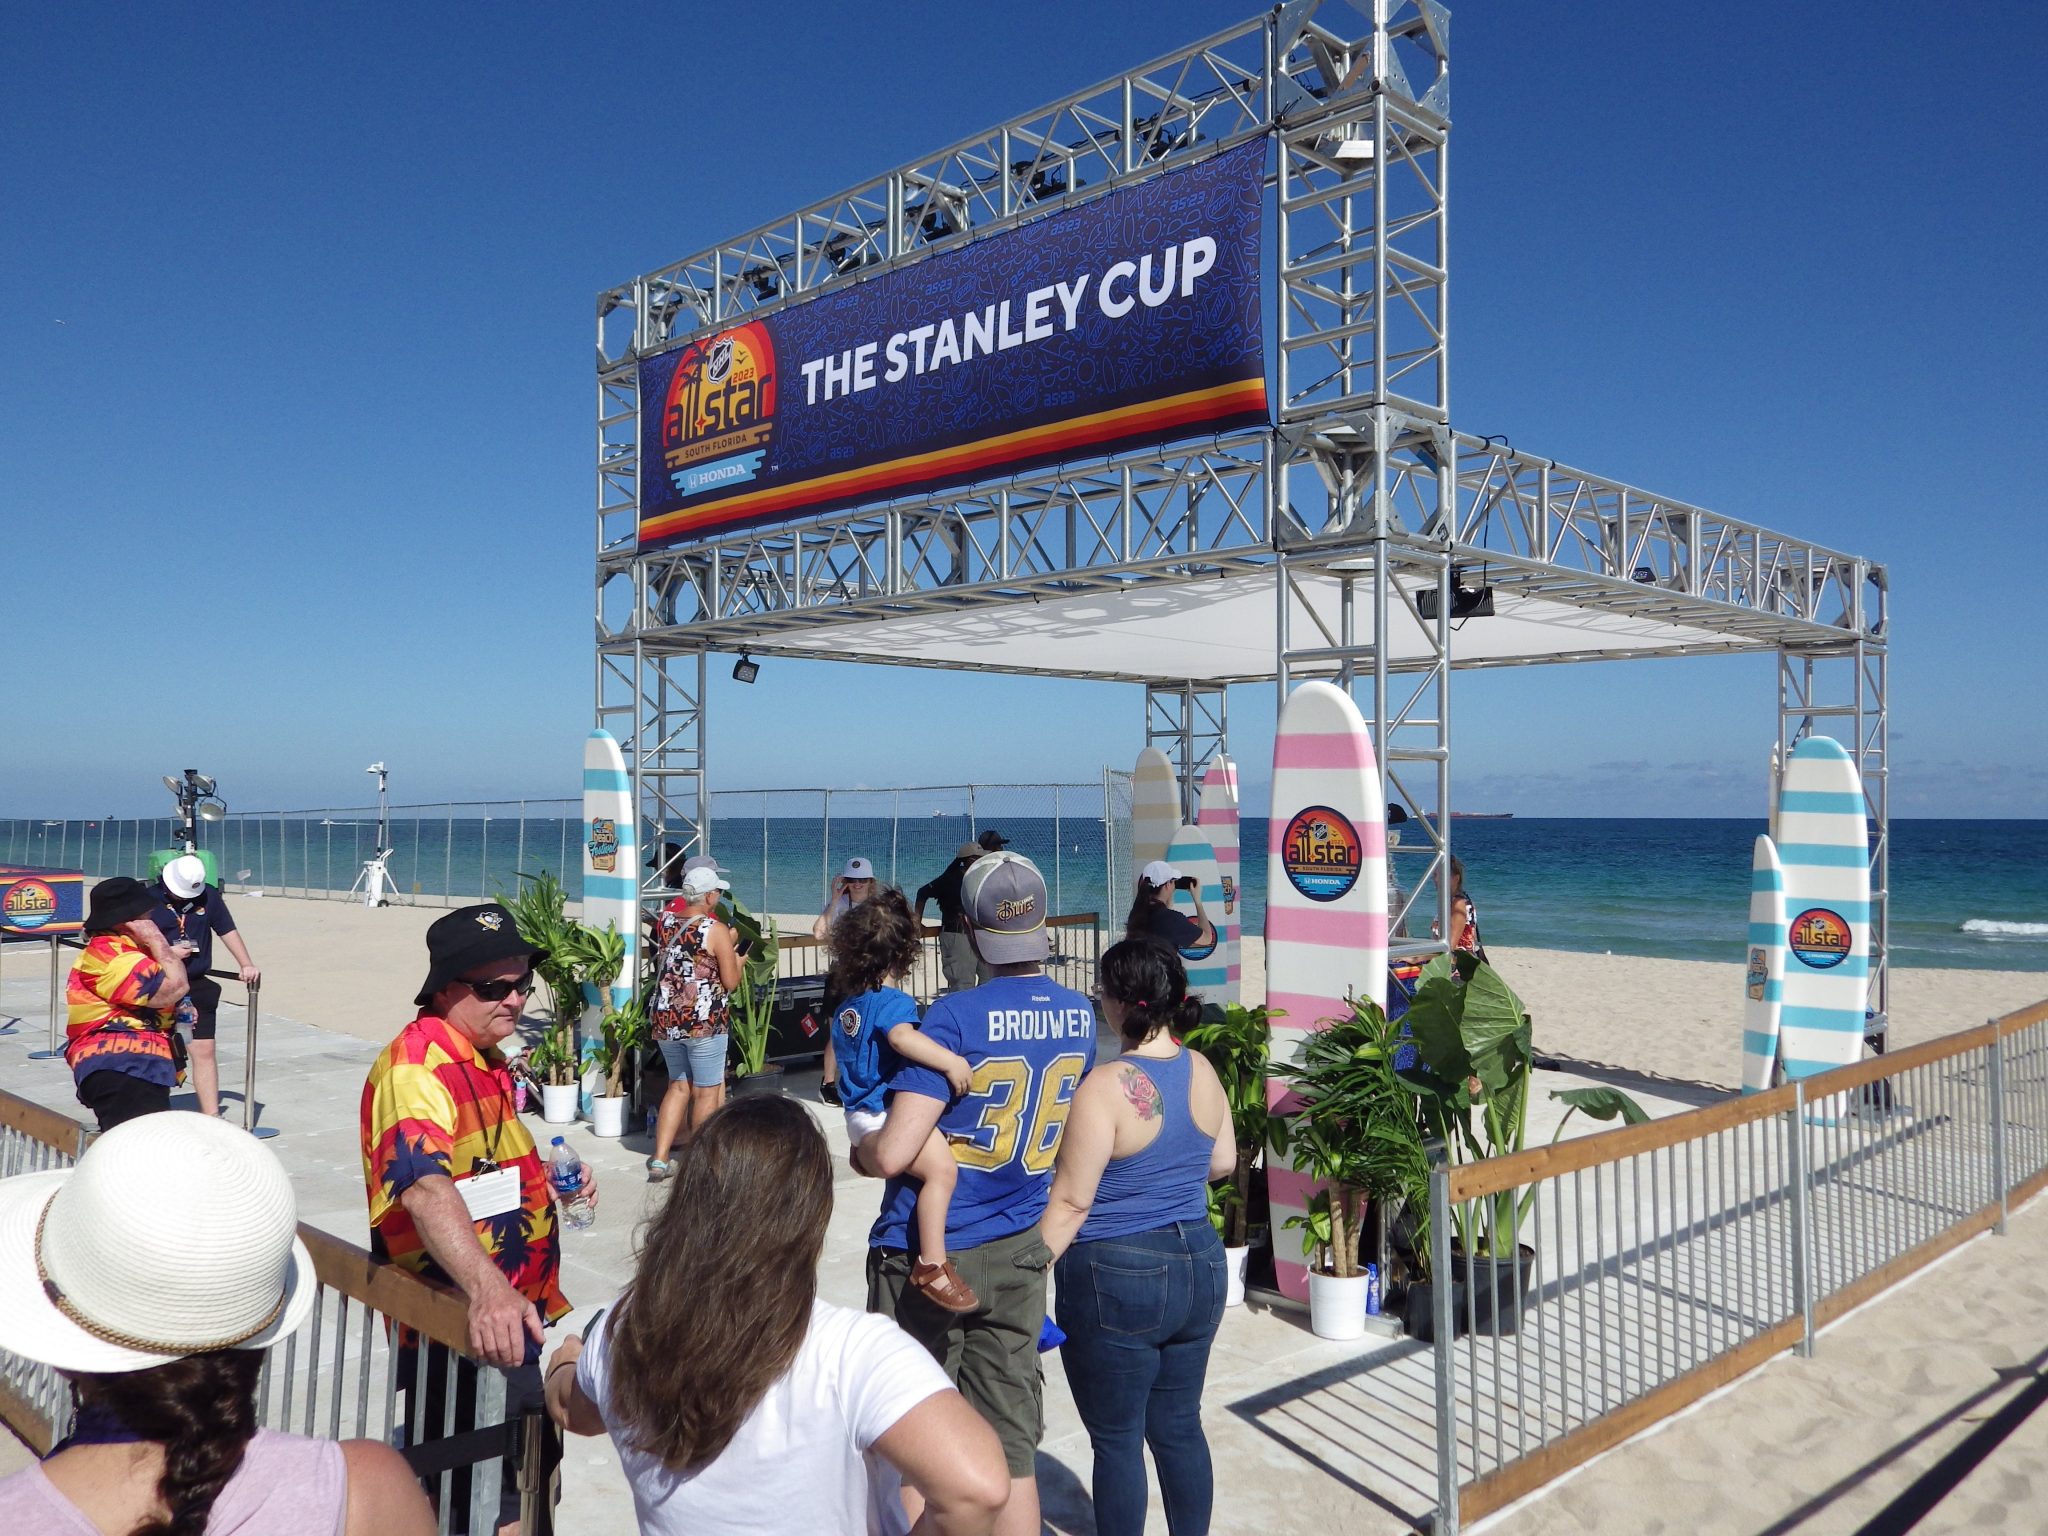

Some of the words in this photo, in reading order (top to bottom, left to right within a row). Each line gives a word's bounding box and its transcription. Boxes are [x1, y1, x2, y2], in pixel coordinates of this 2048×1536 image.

[802, 342, 878, 406] THE
[884, 273, 1090, 383] STANLEY
[1098, 236, 1217, 318] CUP
[713, 347, 730, 372] NHL
[732, 367, 755, 384] 2023
[684, 443, 711, 459] SOUTH
[713, 434, 748, 451] FLORIDA
[698, 464, 746, 485] HONDA
[988, 1009, 1091, 1042] BROUWER
[950, 1053, 1086, 1176] 36
